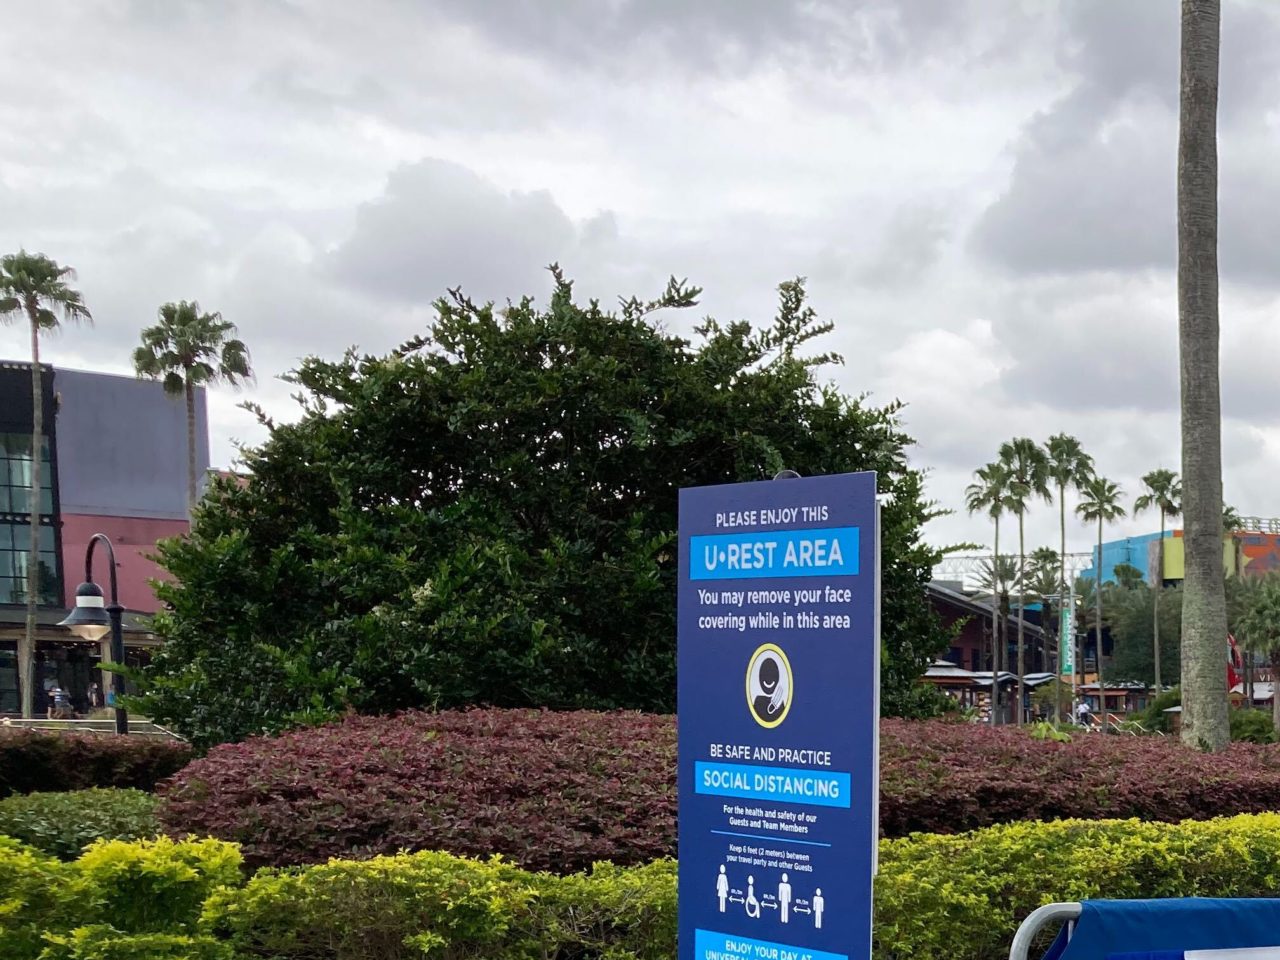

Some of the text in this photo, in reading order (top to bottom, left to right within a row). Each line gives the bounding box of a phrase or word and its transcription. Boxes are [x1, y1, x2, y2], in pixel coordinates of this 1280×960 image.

[716, 506, 829, 528] PLEASE ENJOY THIS
[783, 539, 843, 568] AREA
[698, 586, 852, 607] You may remove your face
[698, 612, 851, 632] covering while in this area
[710, 743, 831, 766] BE SAFE AND PRACTICE
[703, 769, 839, 798] SOCIAL DISTANCING
[723, 804, 817, 823] For the health and safety of our
[729, 816, 809, 834] Guests and Team Members
[729, 843, 810, 861] Keep 6 feet (2 meters) between
[726, 854, 813, 872] your travel party and other Guests
[725, 939, 753, 954] ENJOY
[754, 945, 779, 960] YOUR
